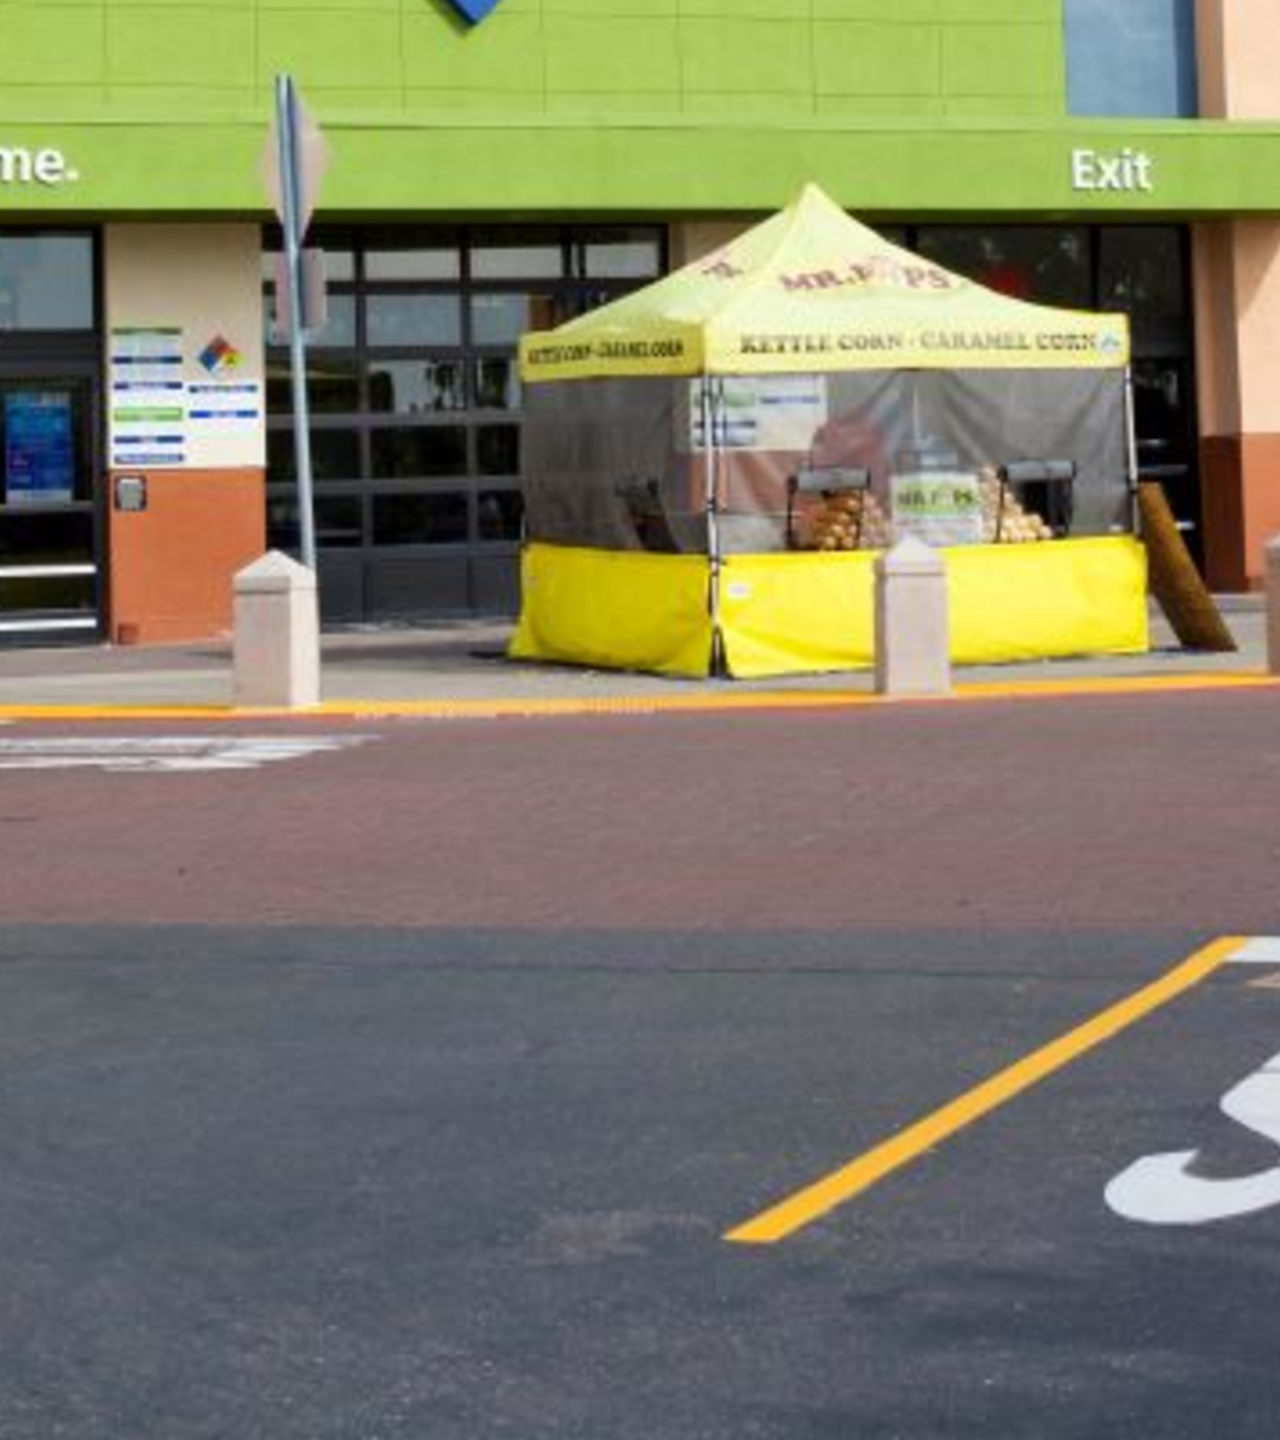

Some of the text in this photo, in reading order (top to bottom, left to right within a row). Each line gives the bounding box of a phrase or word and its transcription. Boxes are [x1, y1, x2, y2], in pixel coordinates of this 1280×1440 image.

[1071, 147, 1153, 192] Exit
[740, 330, 1095, 354] KETTLE CORN CARAMEL CORN
